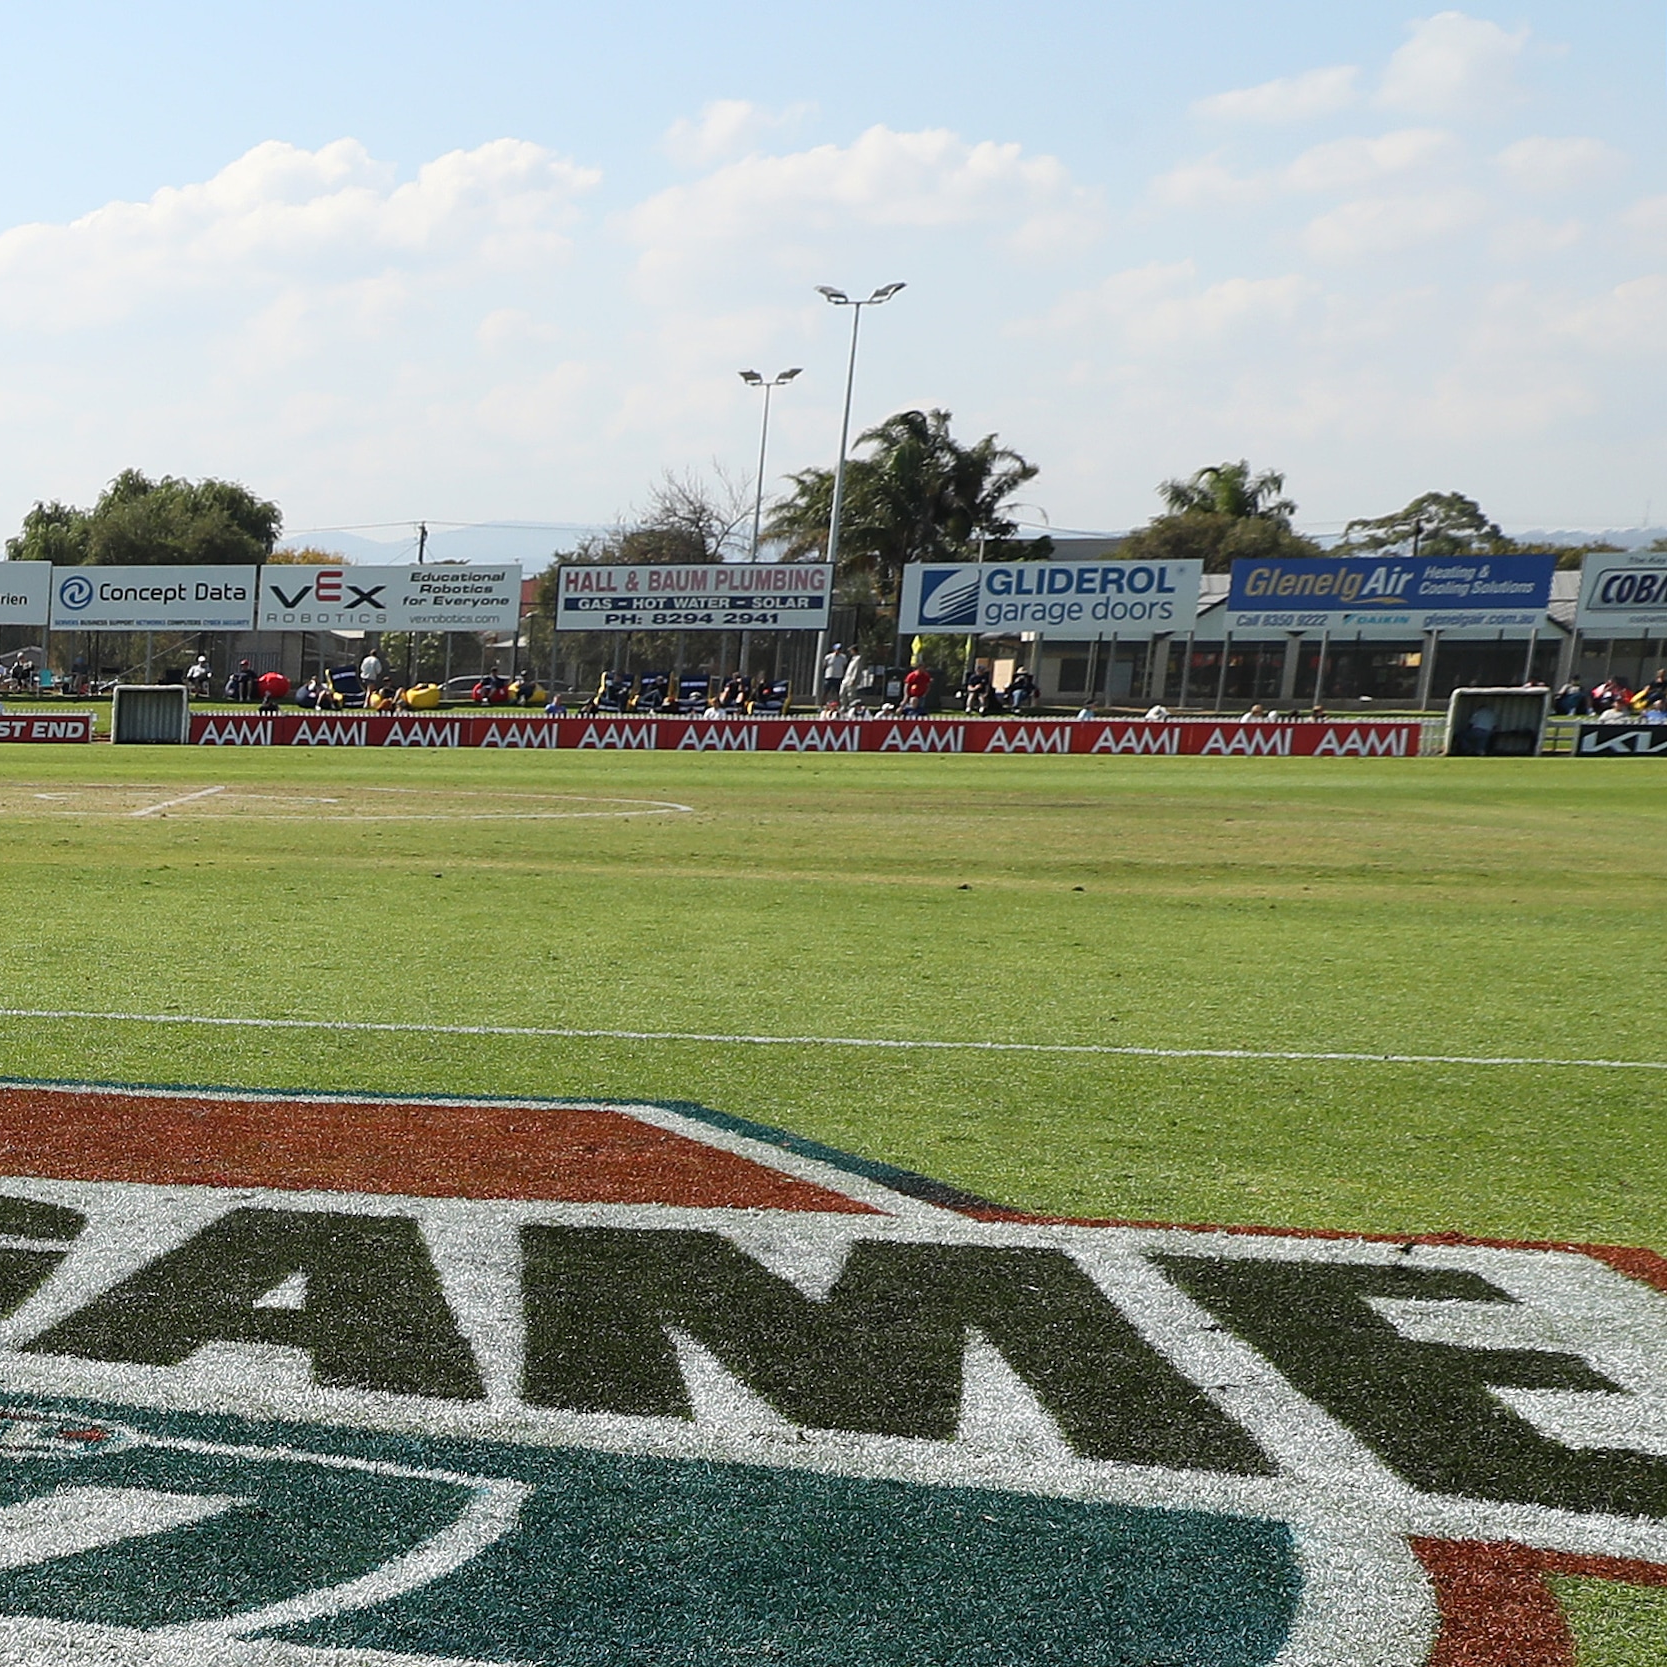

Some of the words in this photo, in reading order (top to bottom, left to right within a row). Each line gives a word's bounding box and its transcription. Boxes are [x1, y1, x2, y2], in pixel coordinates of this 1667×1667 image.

[410, 572, 506, 583] Educational
[565, 572, 618, 592] HALL
[624, 570, 640, 592] &
[648, 570, 708, 592] BAUM
[714, 568, 825, 591] PLUMBING
[985, 566, 1176, 595] GLIDEROL
[1422, 566, 1475, 581] Heating
[1479, 564, 1491, 578] &
[99, 583, 187, 604] Concept
[194, 582, 246, 601] Data
[269, 570, 387, 609] VEX
[419, 584, 493, 594] Robotics
[1418, 582, 1470, 597] Cooling
[1470, 580, 1536, 595] Solutions
[403, 596, 427, 606] for
[433, 596, 509, 608] Everyone
[578, 598, 612, 610] GAS
[632, 598, 668, 609] HOT
[673, 598, 730, 609] WATER
[751, 597, 809, 608] SOLAR
[985, 602, 1083, 626] garage
[1091, 597, 1173, 622] doors
[267, 614, 387, 624] ROBOTICS
[410, 614, 500, 624] vexrobotics.com
[605, 614, 643, 625] PH:
[651, 613, 714, 625] 8294
[722, 612, 780, 624] 2941
[30, 721, 85, 739] END
[198, 720, 273, 746] AAMI
[291, 720, 368, 746] AAMI
[383, 721, 461, 747] AAMI
[479, 722, 559, 748] AAMI
[577, 723, 657, 750] AAMI
[677, 724, 759, 751] AAMI
[777, 724, 861, 752] AAMI
[879, 724, 965, 752] AAMI
[983, 726, 1072, 754] AAMI
[1091, 726, 1181, 754] AAMI
[1200, 726, 1293, 756] AAMI
[1313, 727, 1409, 756] AAMI
[1581, 730, 1667, 752] KI
